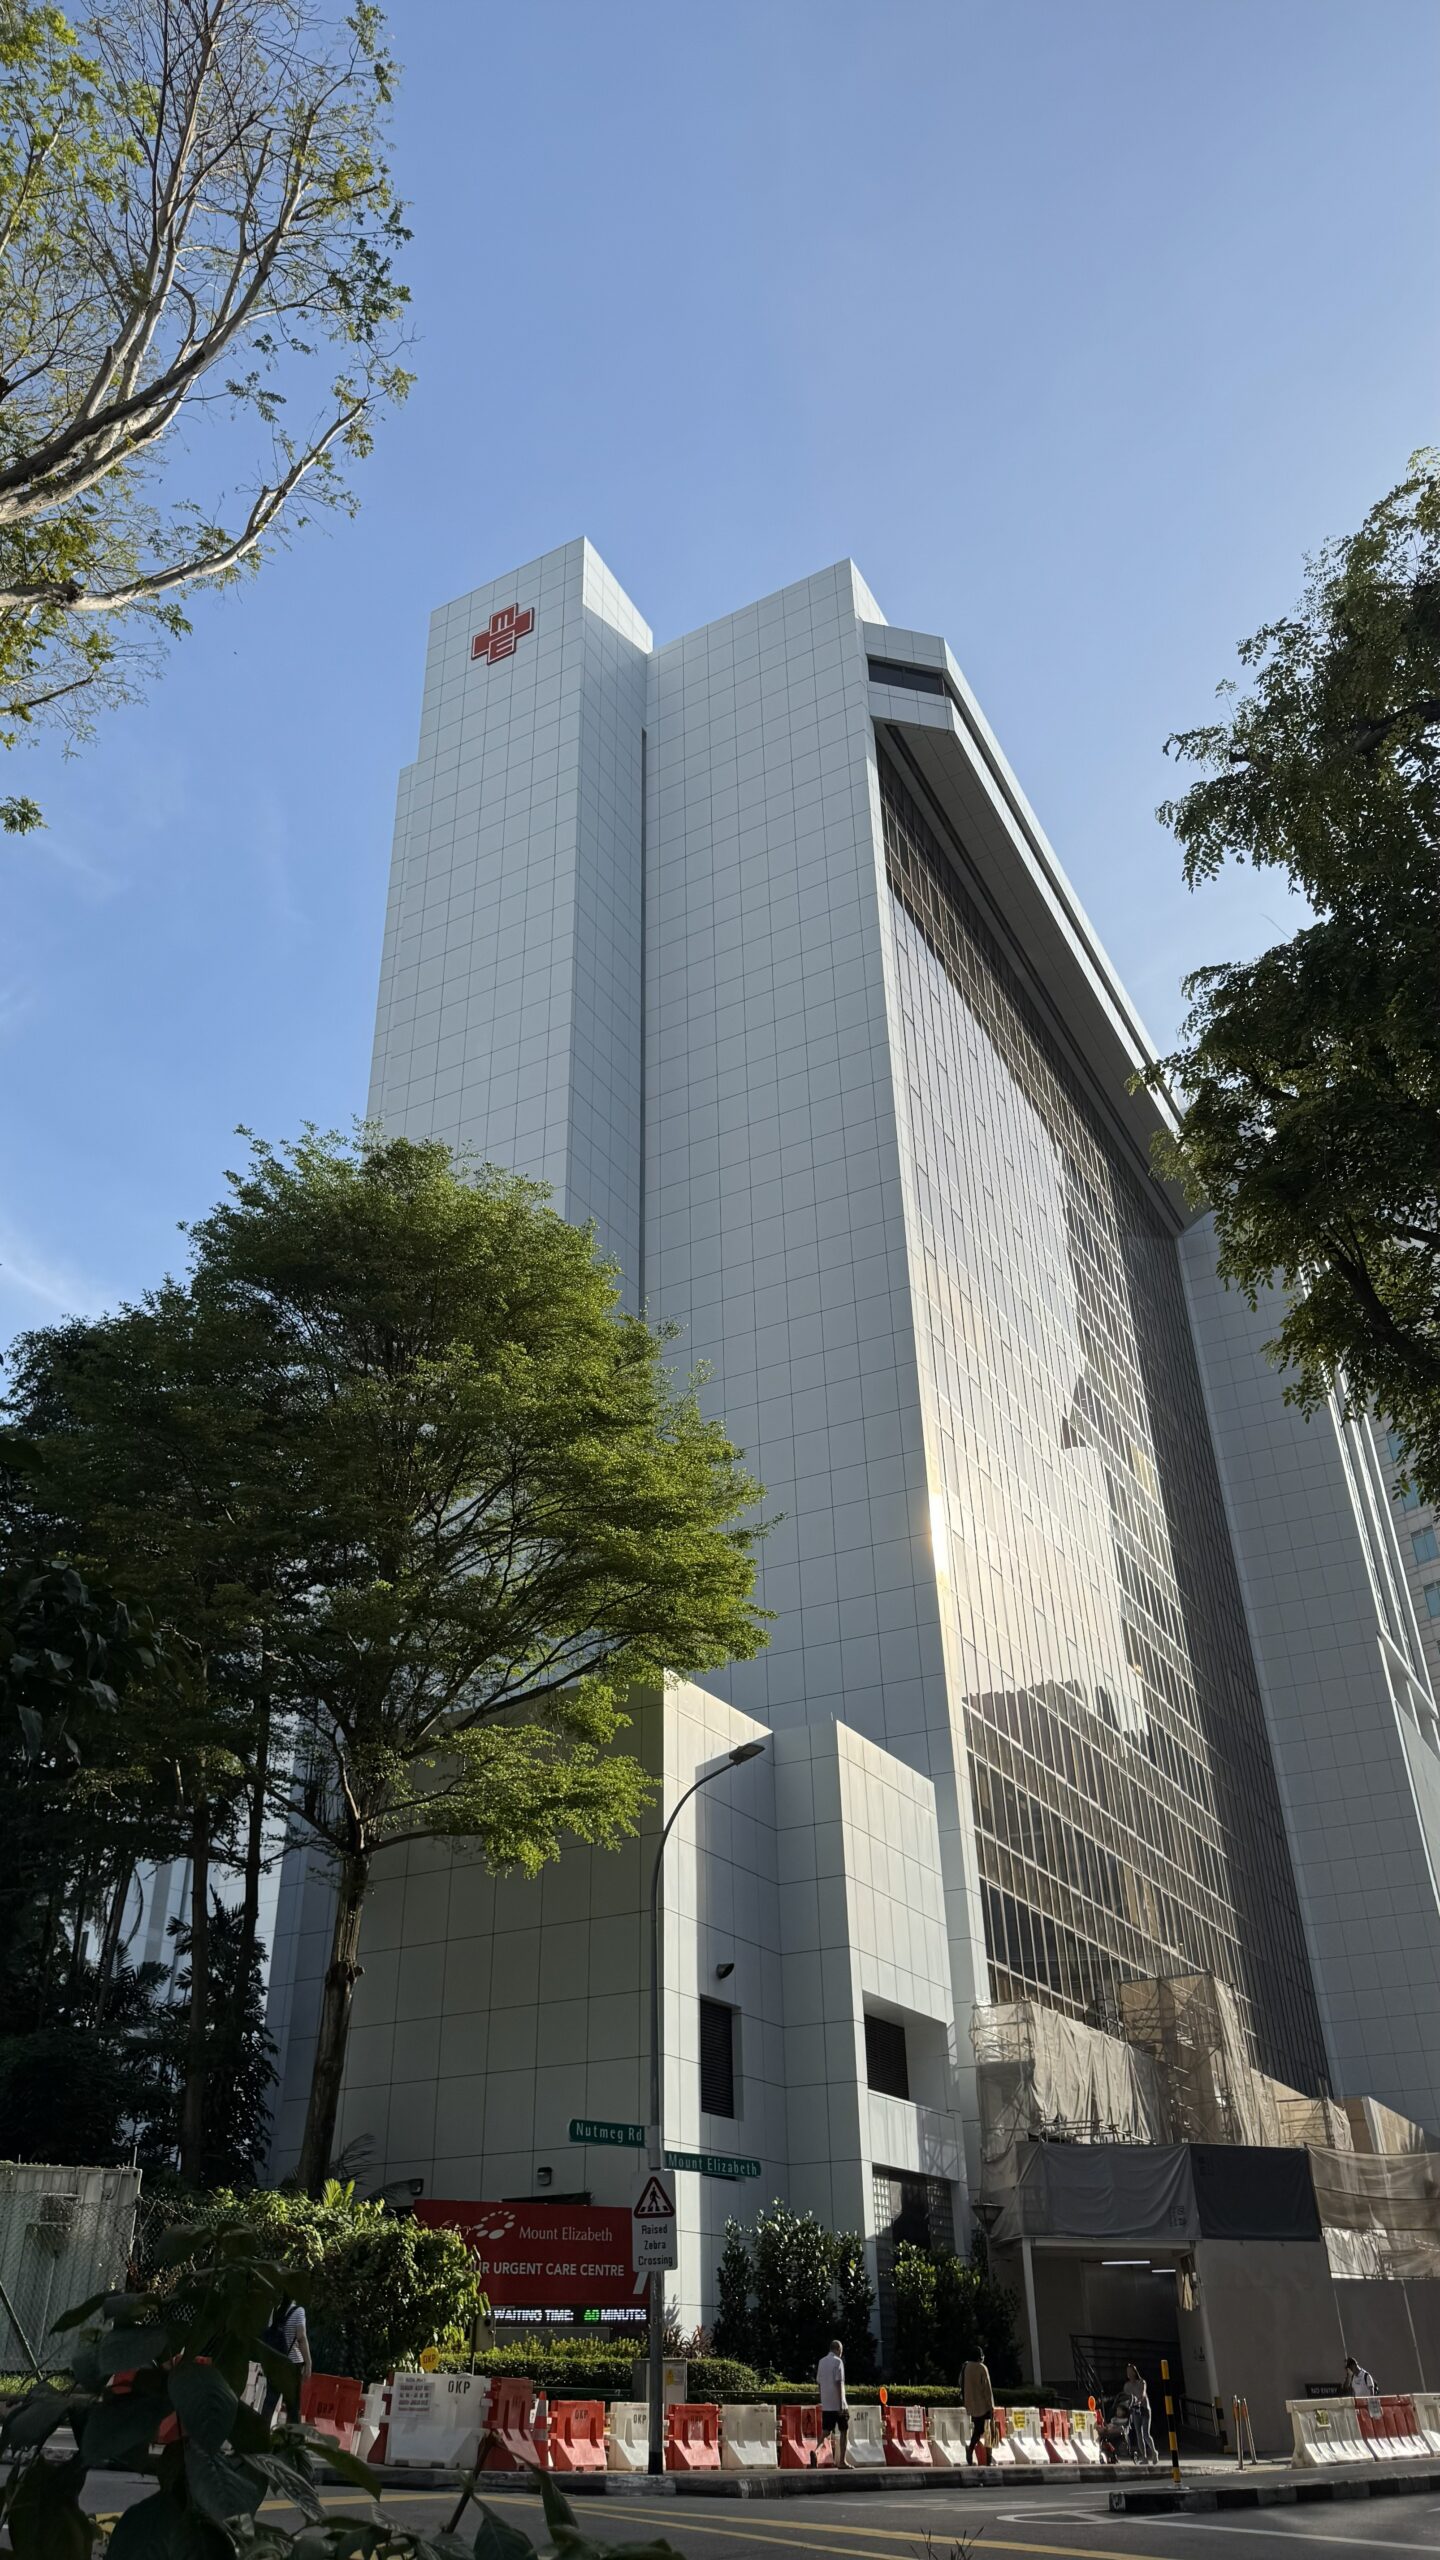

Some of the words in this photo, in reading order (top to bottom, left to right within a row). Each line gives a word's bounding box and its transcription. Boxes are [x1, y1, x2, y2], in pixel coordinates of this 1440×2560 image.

[576, 2122, 624, 2142] Nutmeg
[628, 2127, 642, 2142] Rd
[668, 2154, 703, 2170] Mount
[707, 2157, 757, 2176] Elizabeth
[519, 2226, 558, 2240] Mount
[562, 2226, 613, 2242] Elizabeth
[641, 2224, 668, 2235] Raised
[644, 2240, 666, 2250] Zebra
[638, 2255, 673, 2267] Crossing
[493, 2262, 542, 2275] URGENT
[545, 2263, 577, 2276] CARE
[580, 2264, 624, 2276] CENTRE
[493, 2309, 543, 2321] WAITING
[545, 2309, 574, 2321] TIME:
[600, 2309, 647, 2320] MINUTES
[448, 2380, 471, 2394] OKP
[574, 2409, 588, 2420] OKP
[633, 2414, 647, 2425] OKP
